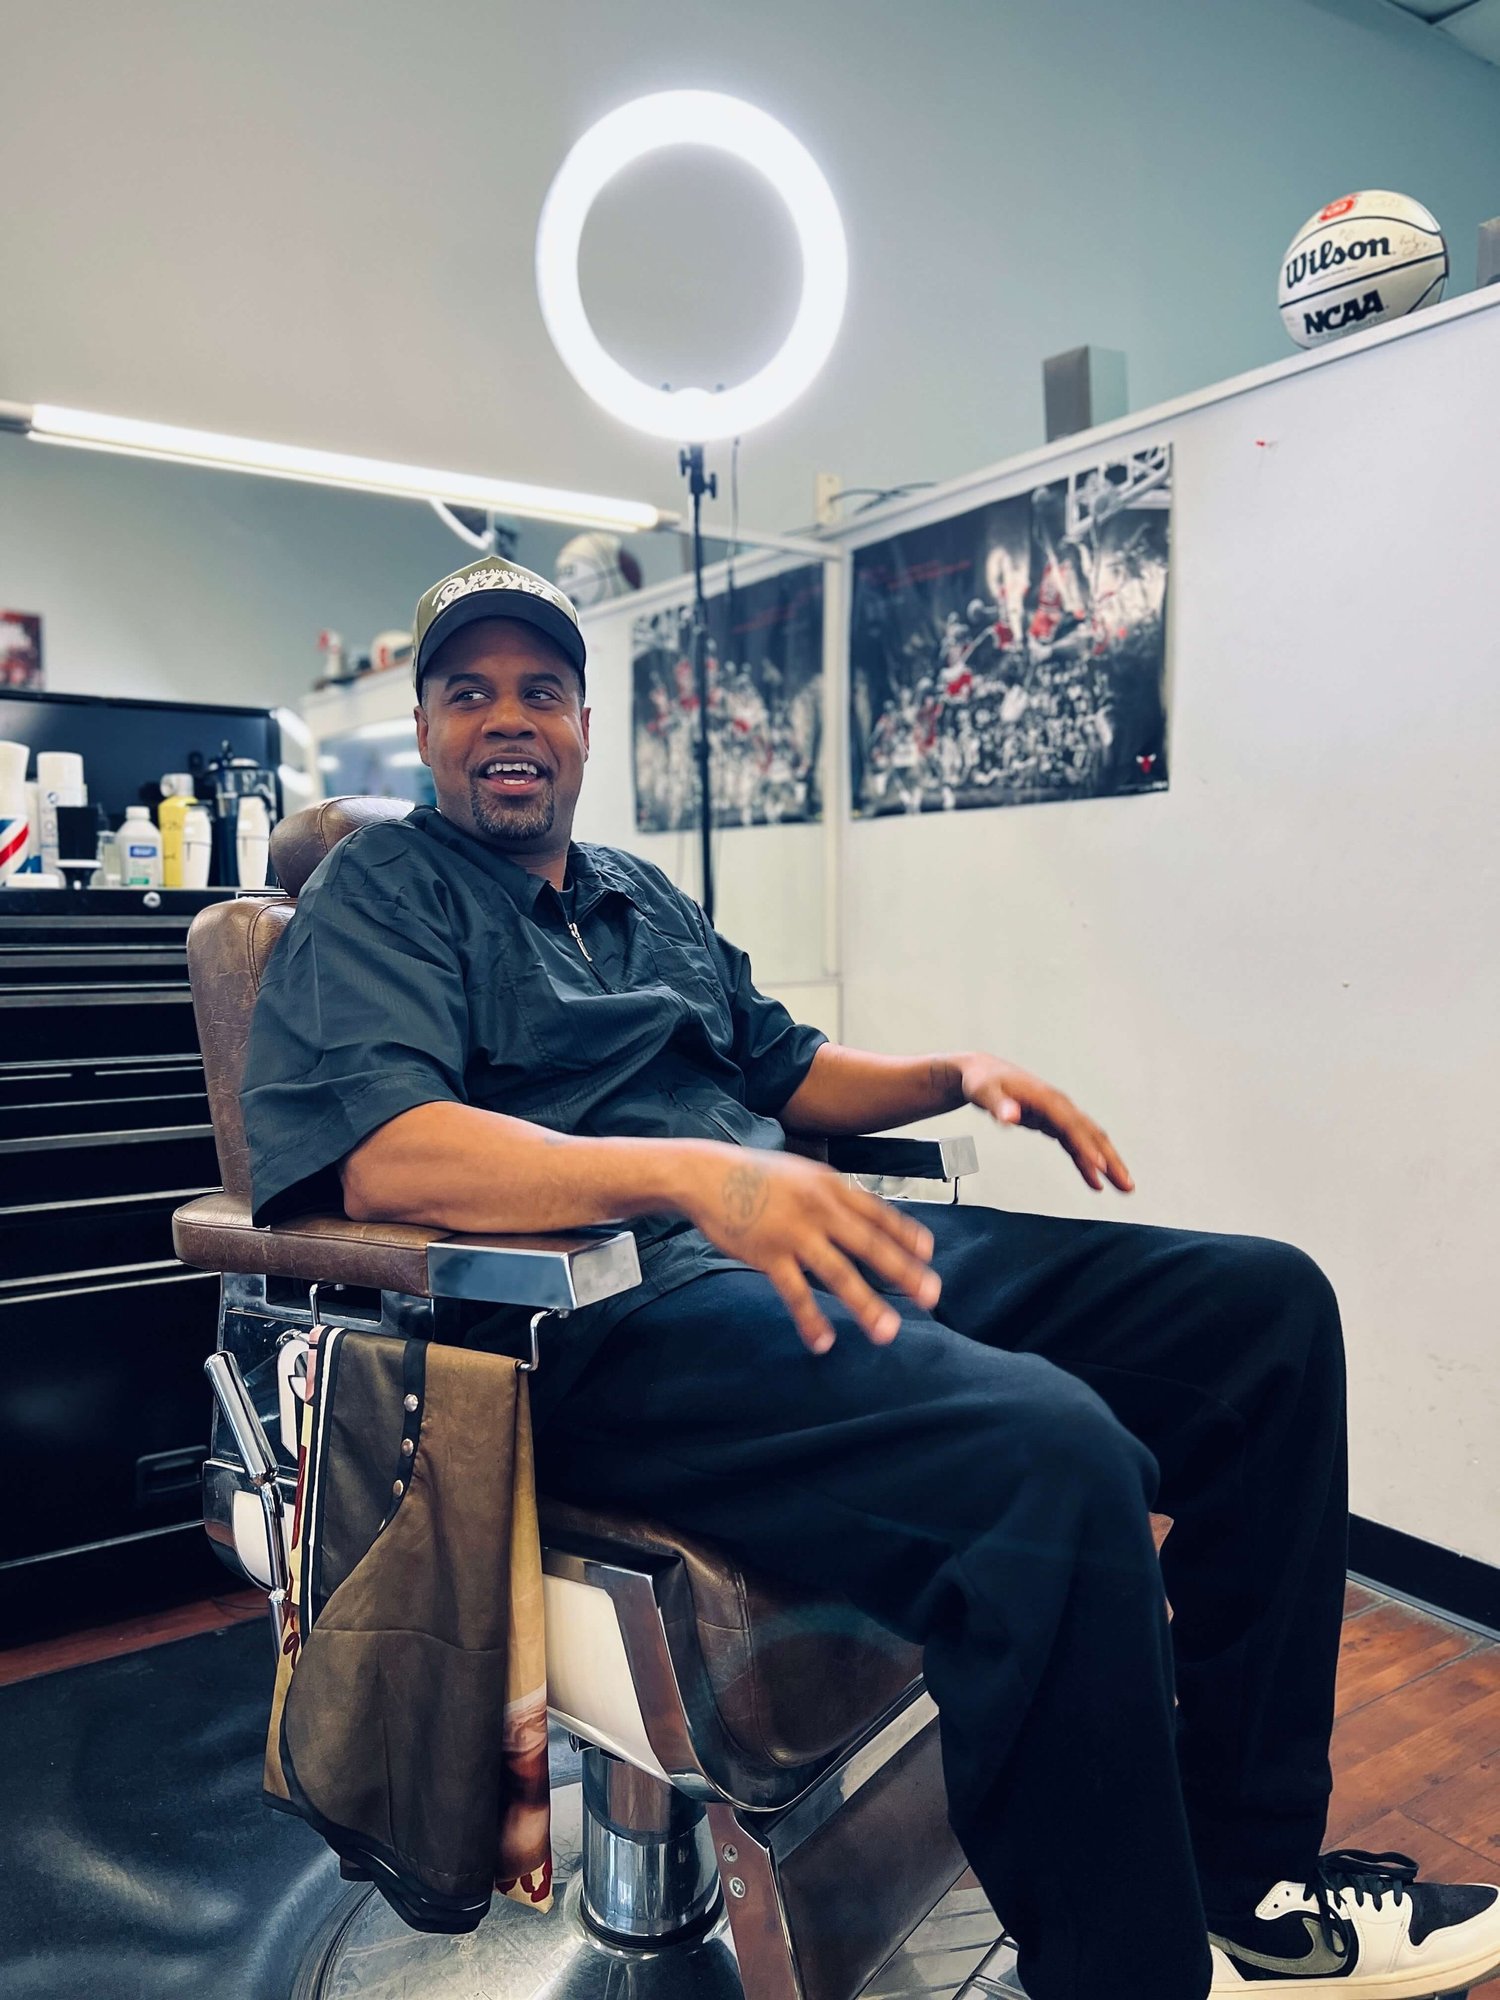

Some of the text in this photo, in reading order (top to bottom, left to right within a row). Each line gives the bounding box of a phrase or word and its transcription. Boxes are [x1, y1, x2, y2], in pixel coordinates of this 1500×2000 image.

[1286, 237, 1391, 289] Wilson
[1303, 289, 1384, 334] NCAA
[467, 569, 487, 581] LOS
